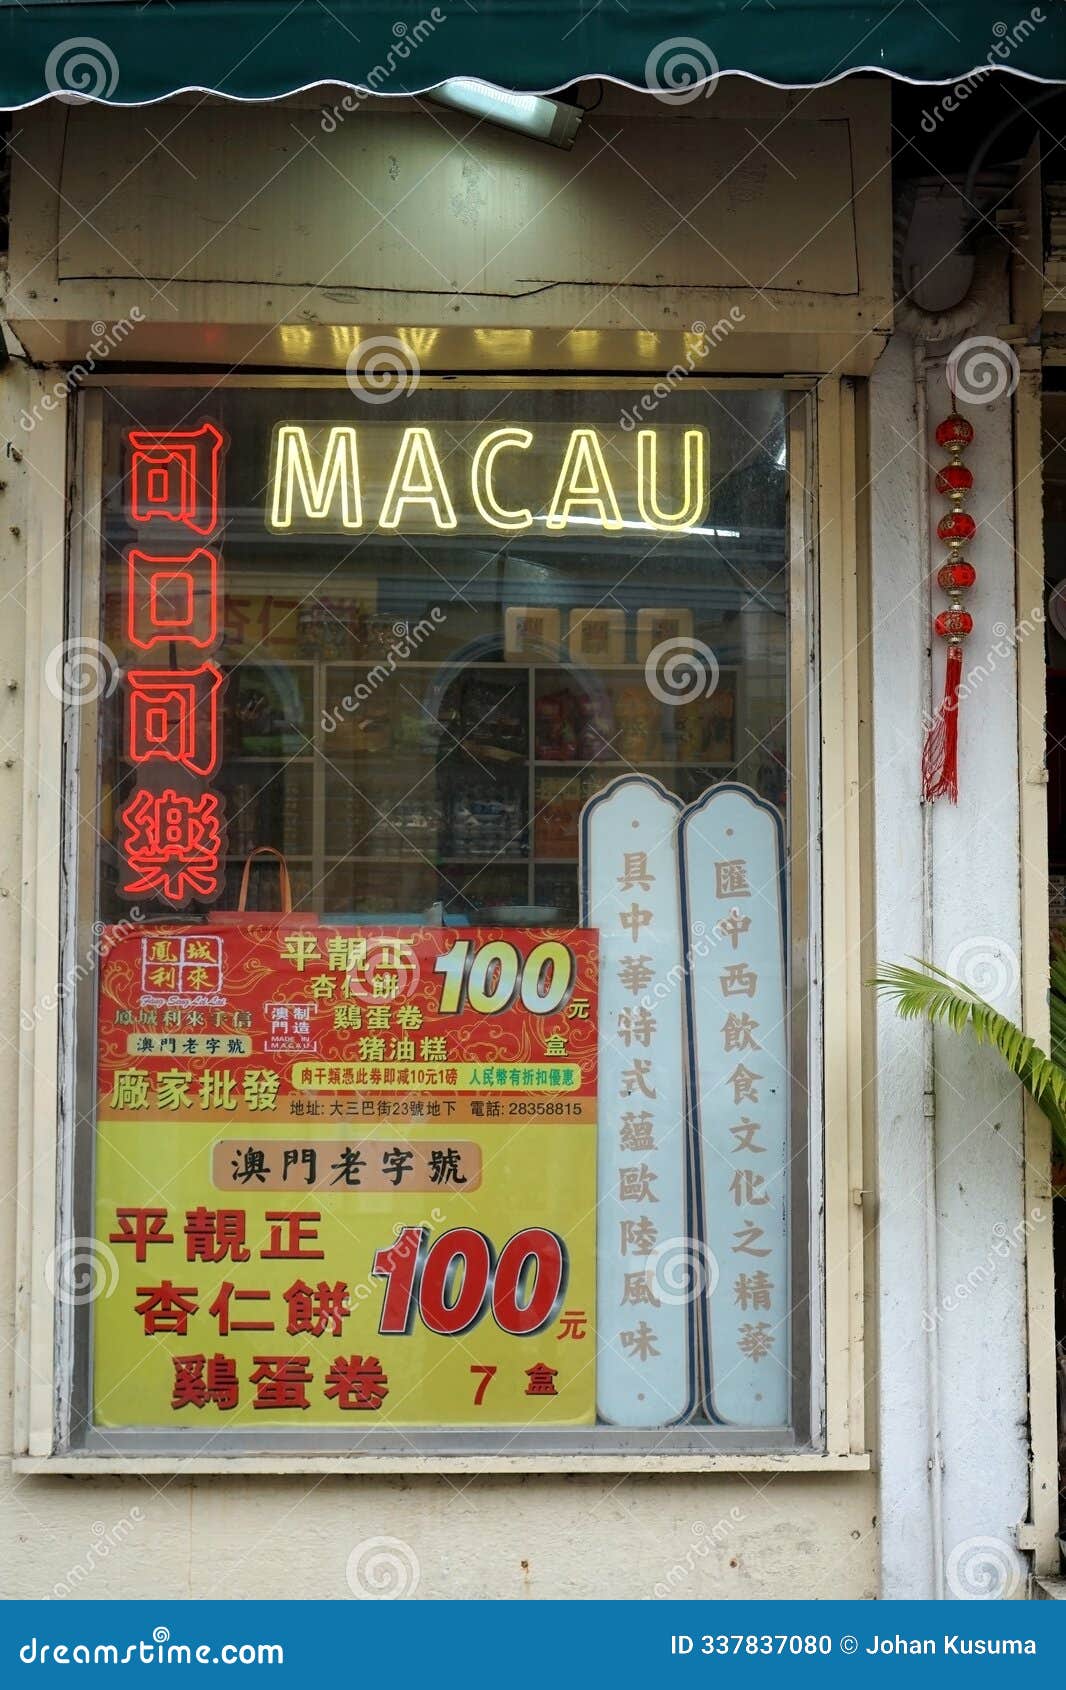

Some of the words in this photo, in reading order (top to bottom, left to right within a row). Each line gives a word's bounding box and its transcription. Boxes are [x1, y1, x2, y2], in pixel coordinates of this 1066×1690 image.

[270, 426, 706, 531] MACAU
[122, 423, 223, 899] 可口可樂
[149, 940, 216, 964] 鳳城
[281, 936, 418, 972] 平靚正
[149, 967, 214, 991] 利來
[310, 974, 399, 1000] 杏仁餅
[434, 938, 577, 1016] 100
[569, 999, 589, 1020] 元
[137, 1037, 246, 1054] 澳門老字號
[544, 1034, 568, 1056] 盒
[110, 1067, 281, 1111] 廠家批發
[290, 1100, 325, 1116] 地址:
[330, 1100, 456, 1117] 大三巴街23號地下
[470, 1101, 505, 1117] 電話:
[508, 1102, 582, 1115] 28358815
[616, 851, 661, 1362] 具中華特式蘊歐陸風味
[713, 859, 775, 1363] 匯中西飲食文化之精華
[231, 1147, 468, 1186] 澳門老字號
[109, 1207, 326, 1263] 平靚正
[371, 1226, 568, 1336] 100
[134, 1280, 351, 1338] 杏仁餅
[556, 1311, 587, 1340] 元
[469, 1365, 498, 1406] 7
[524, 1363, 559, 1396] 盒
